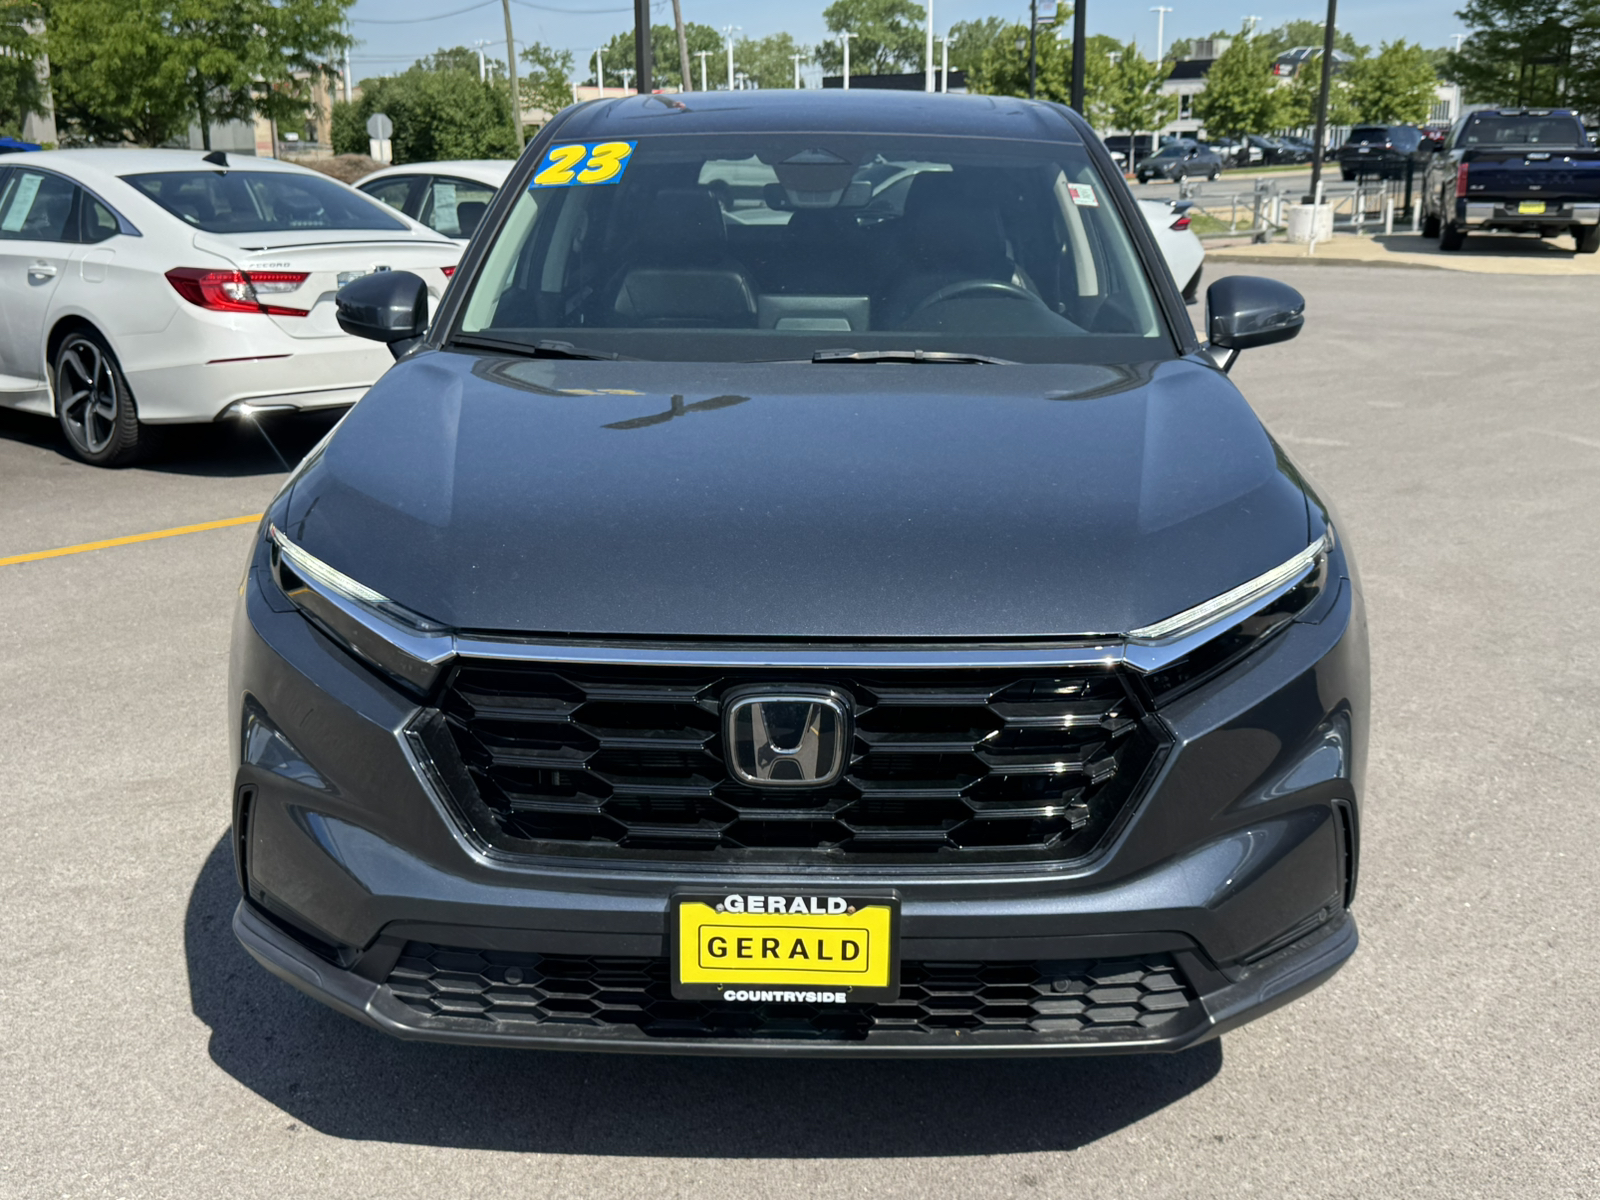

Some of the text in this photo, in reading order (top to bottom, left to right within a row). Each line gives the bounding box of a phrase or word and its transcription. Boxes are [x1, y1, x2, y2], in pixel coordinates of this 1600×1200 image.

[534, 141, 632, 186] 23
[723, 894, 848, 914] GERALD
[707, 936, 860, 961] GERALD
[723, 990, 847, 1004] COUNTRYSIDE
